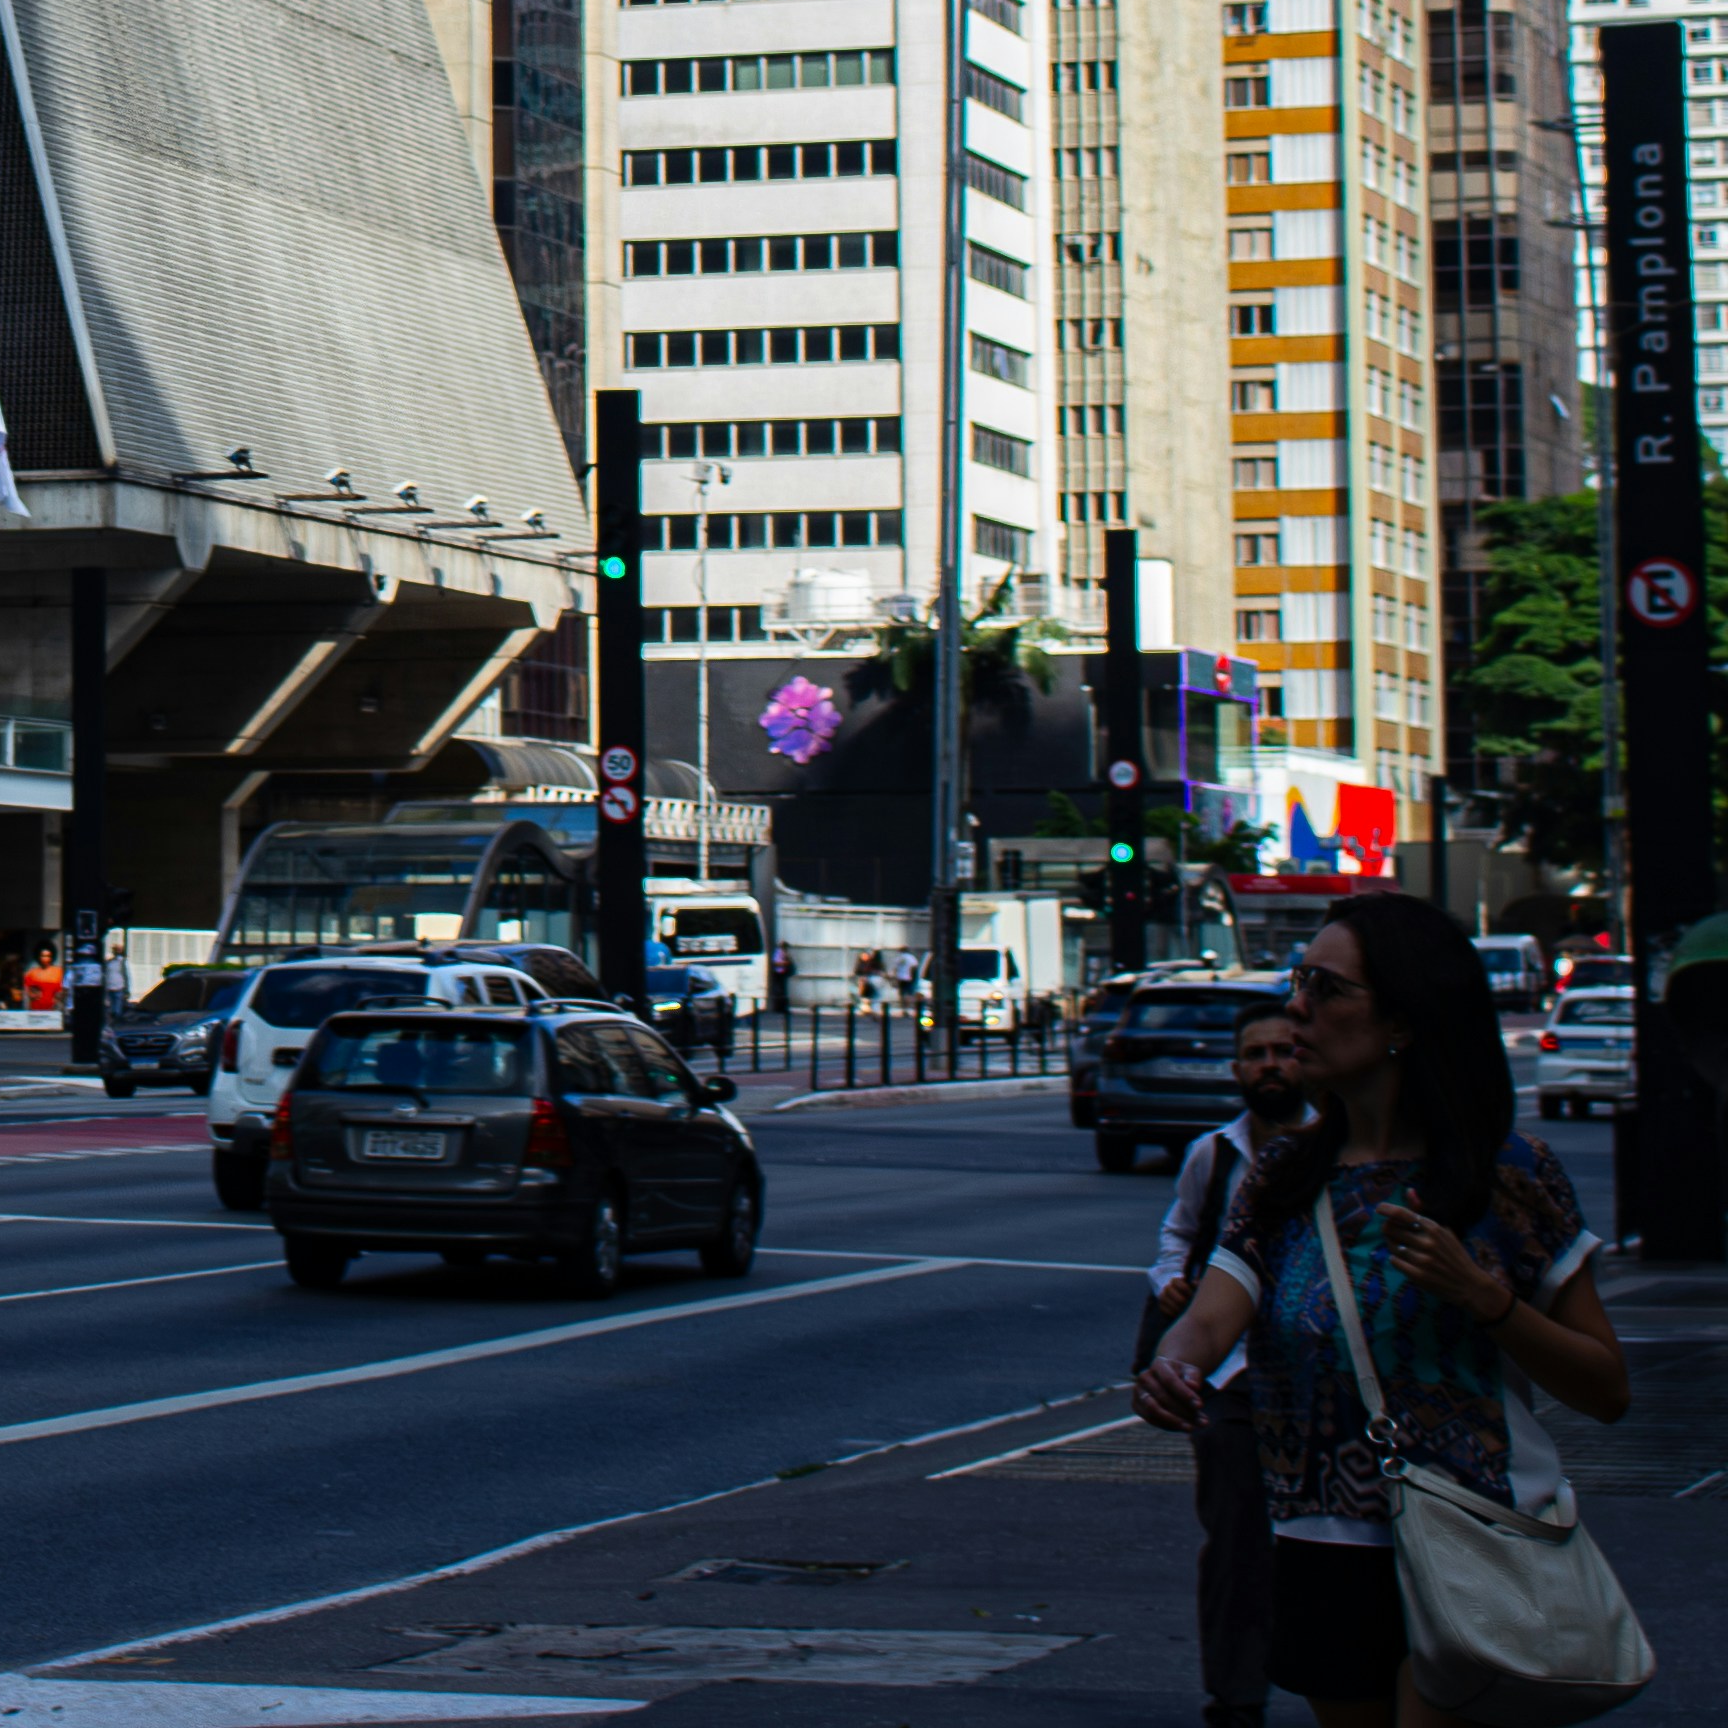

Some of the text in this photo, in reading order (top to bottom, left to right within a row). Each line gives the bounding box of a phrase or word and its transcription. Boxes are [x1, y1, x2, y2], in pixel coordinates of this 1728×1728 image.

[1630, 140, 1676, 465] R. Pamplona
[607, 754, 632, 771] 50
